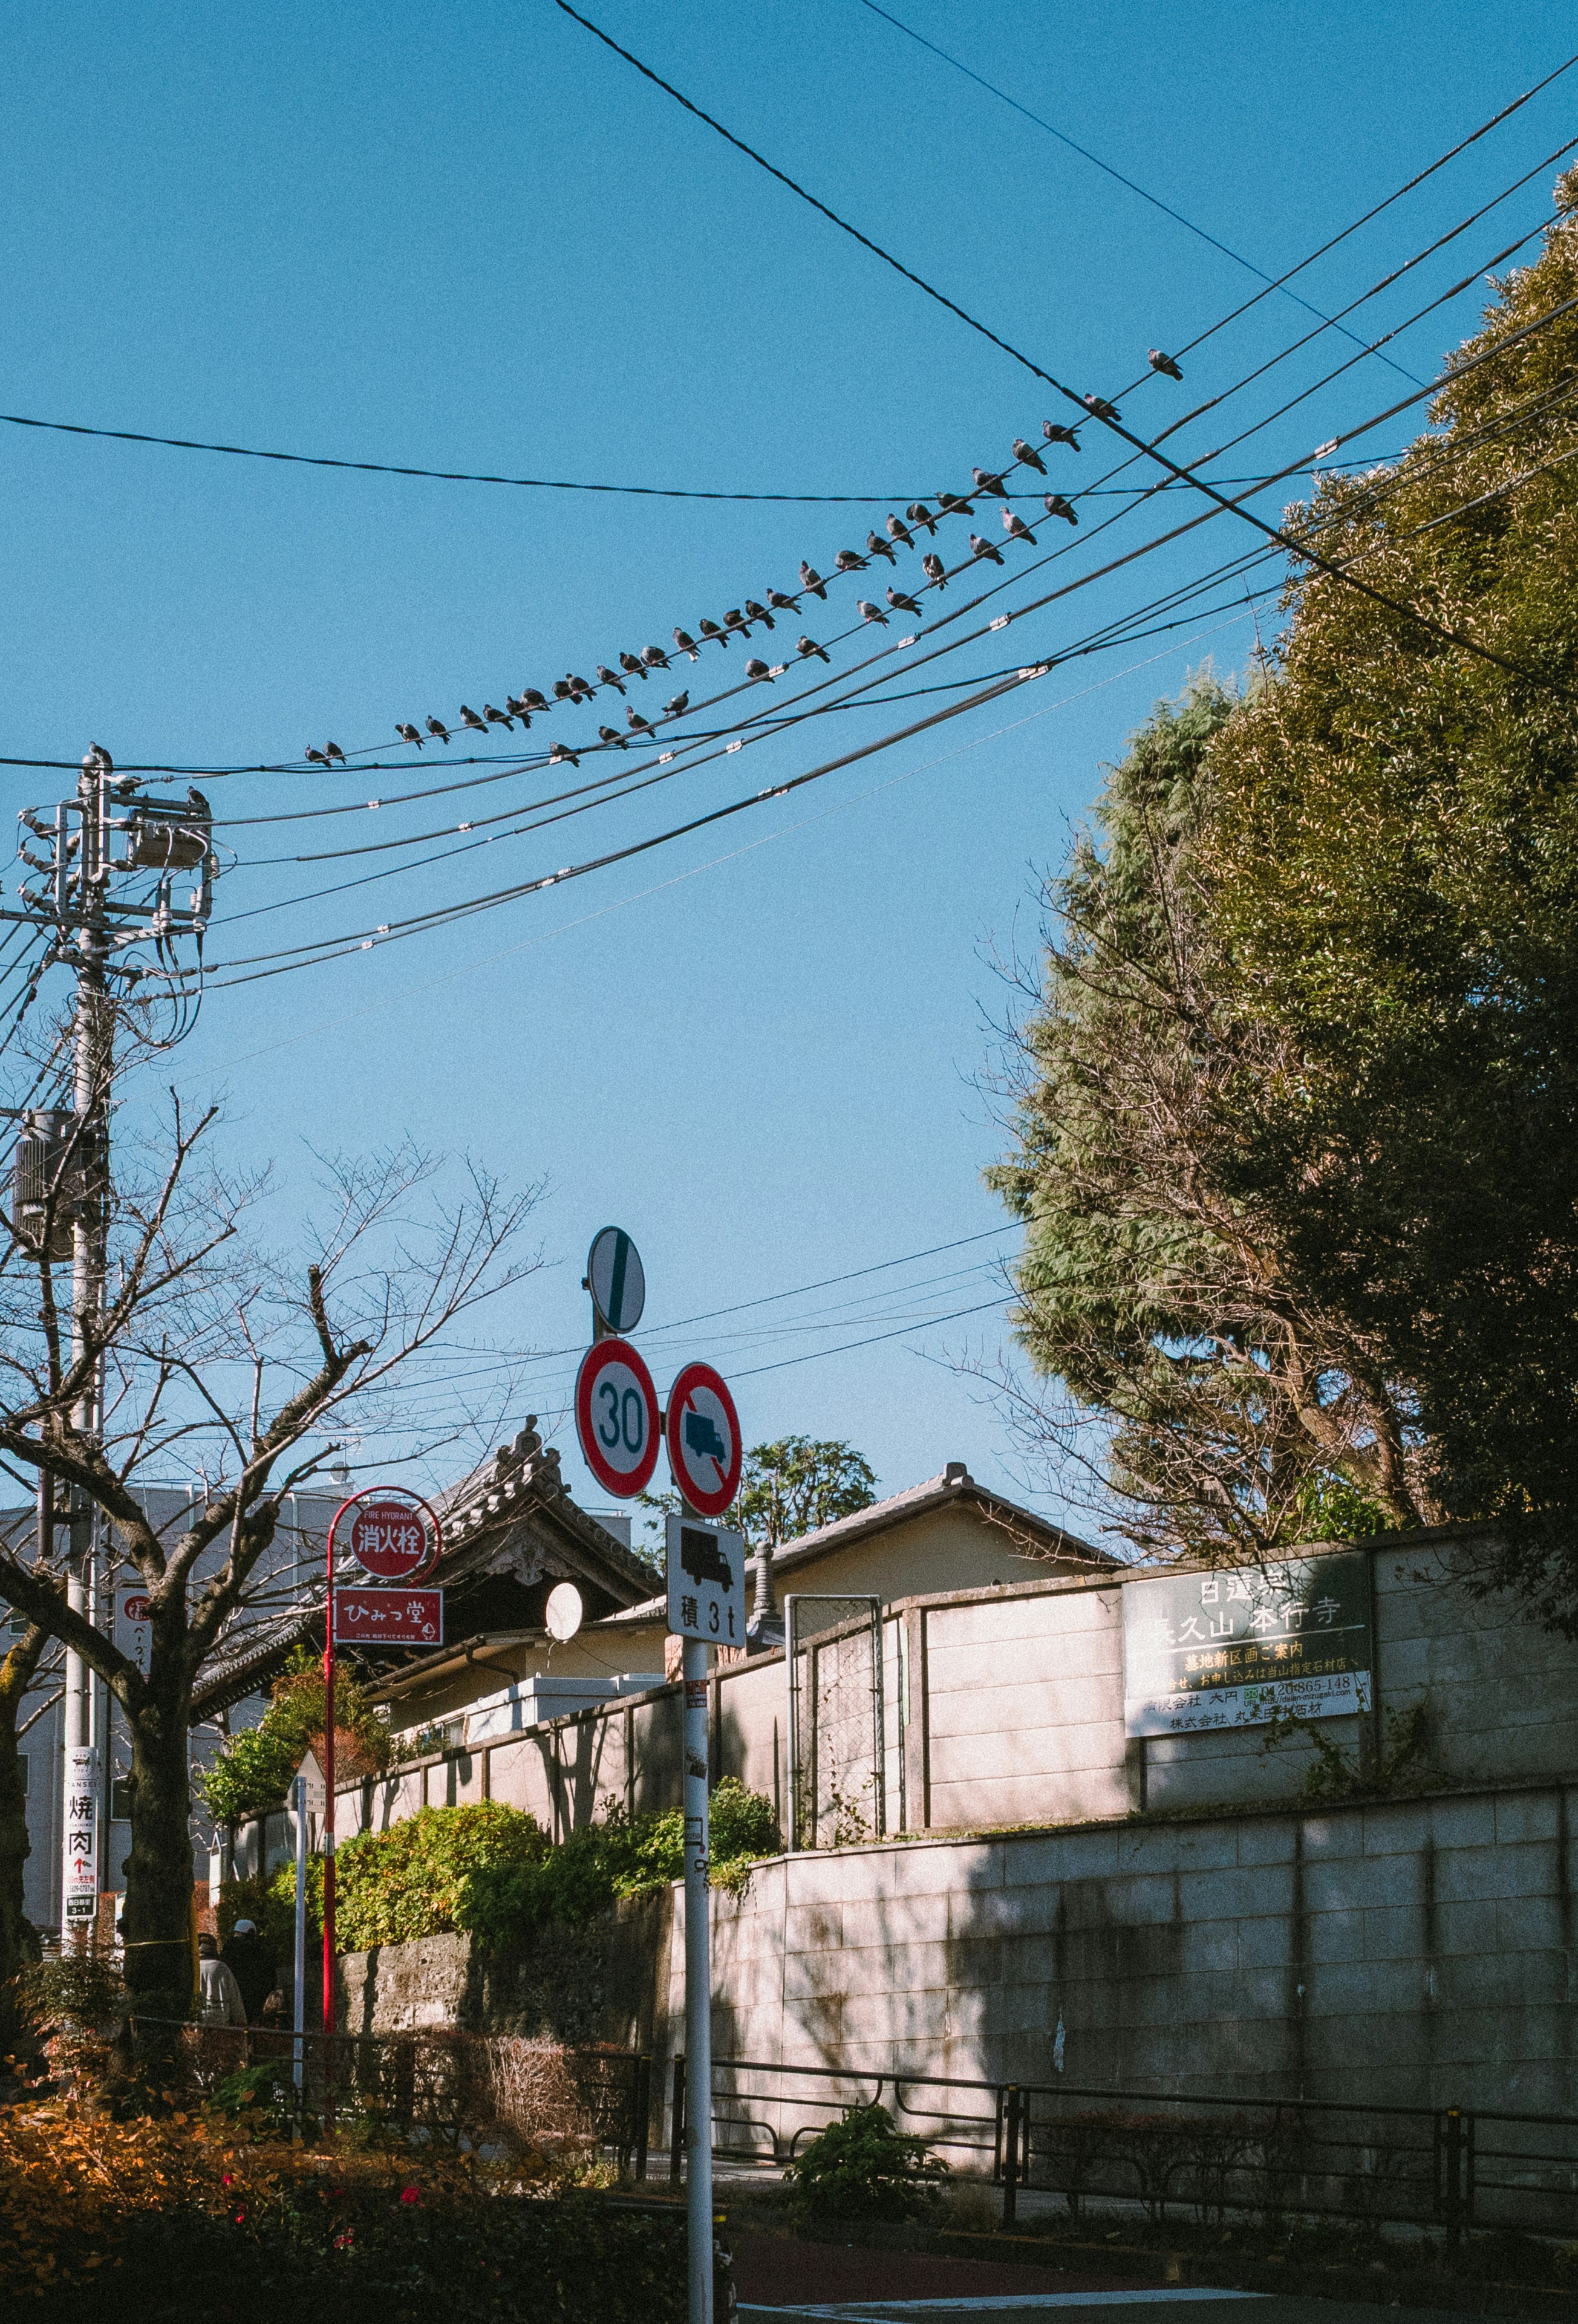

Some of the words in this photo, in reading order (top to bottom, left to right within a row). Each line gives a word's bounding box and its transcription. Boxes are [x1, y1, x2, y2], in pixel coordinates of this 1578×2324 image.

[599, 1381, 643, 1453] 30
[382, 1512, 413, 1520] HYDRANT
[358, 1524, 420, 1554] 消火栓
[1201, 1569, 1286, 1605] 日蓮宗
[344, 1601, 425, 1624] ひみつ堂
[1250, 1596, 1341, 1632] 本行寺
[1185, 1641, 1303, 1673] 墓地新区画ご案内
[1144, 1694, 1202, 1712] 有限会社
[1209, 1690, 1238, 1704] 大円
[1170, 1713, 1227, 1730] 株式会社
